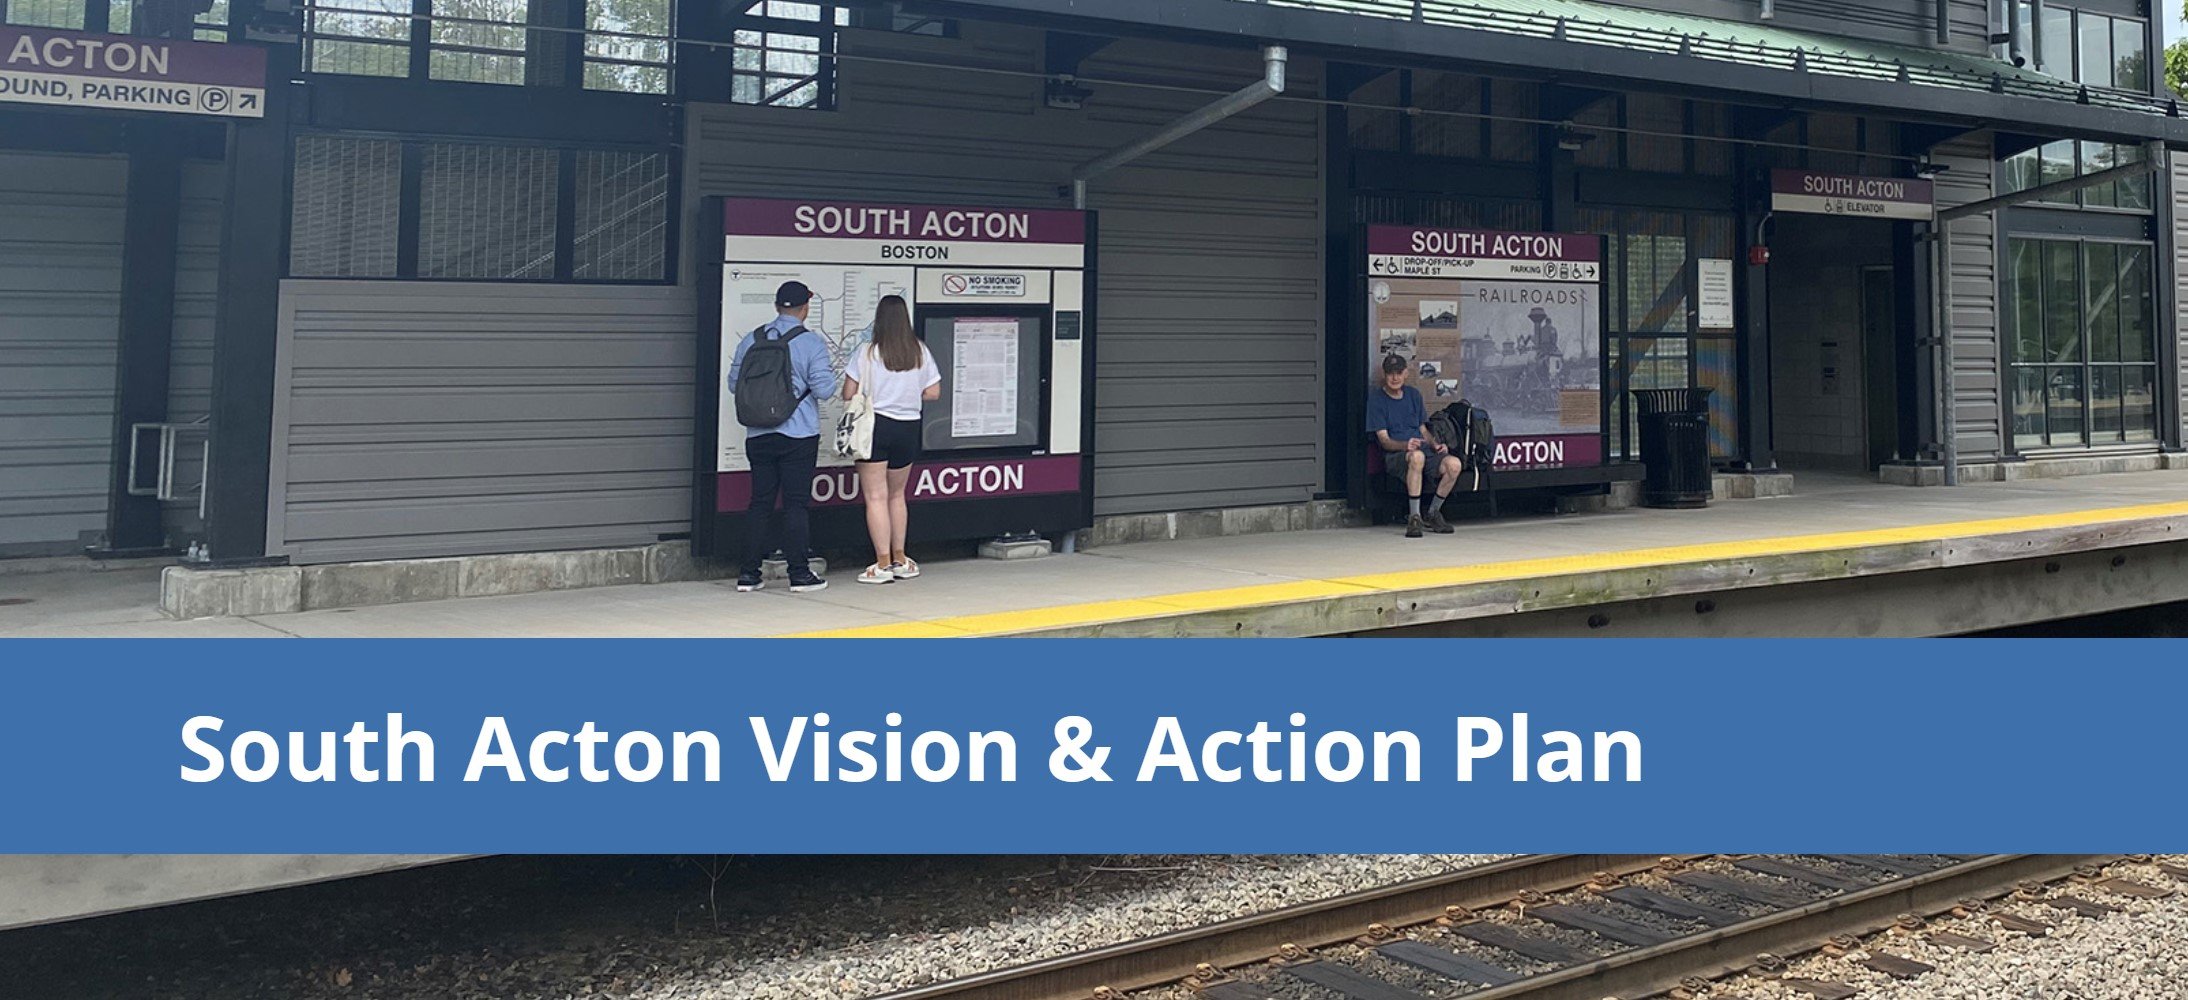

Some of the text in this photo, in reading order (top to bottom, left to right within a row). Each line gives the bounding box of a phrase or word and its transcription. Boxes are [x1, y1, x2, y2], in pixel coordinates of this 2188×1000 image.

[7, 35, 168, 74] ACTON
[82, 83, 191, 105] PARKING
[1804, 175, 1904, 198] SOUTH ACTON
[1847, 202, 1885, 213] ELEVATOR
[794, 206, 1028, 238] SOUTH ACTON
[881, 245, 949, 260] BOSTON
[1411, 230, 1562, 258] SOUTH ACTON
[1404, 266, 1441, 275] MAPLE ST
[1510, 265, 1541, 273] PARKING
[969, 276, 1021, 285] NO SMOKING
[1480, 288, 1578, 304] RAILROADS
[1492, 440, 1564, 465] ACTON
[914, 464, 1024, 496] ACTON
